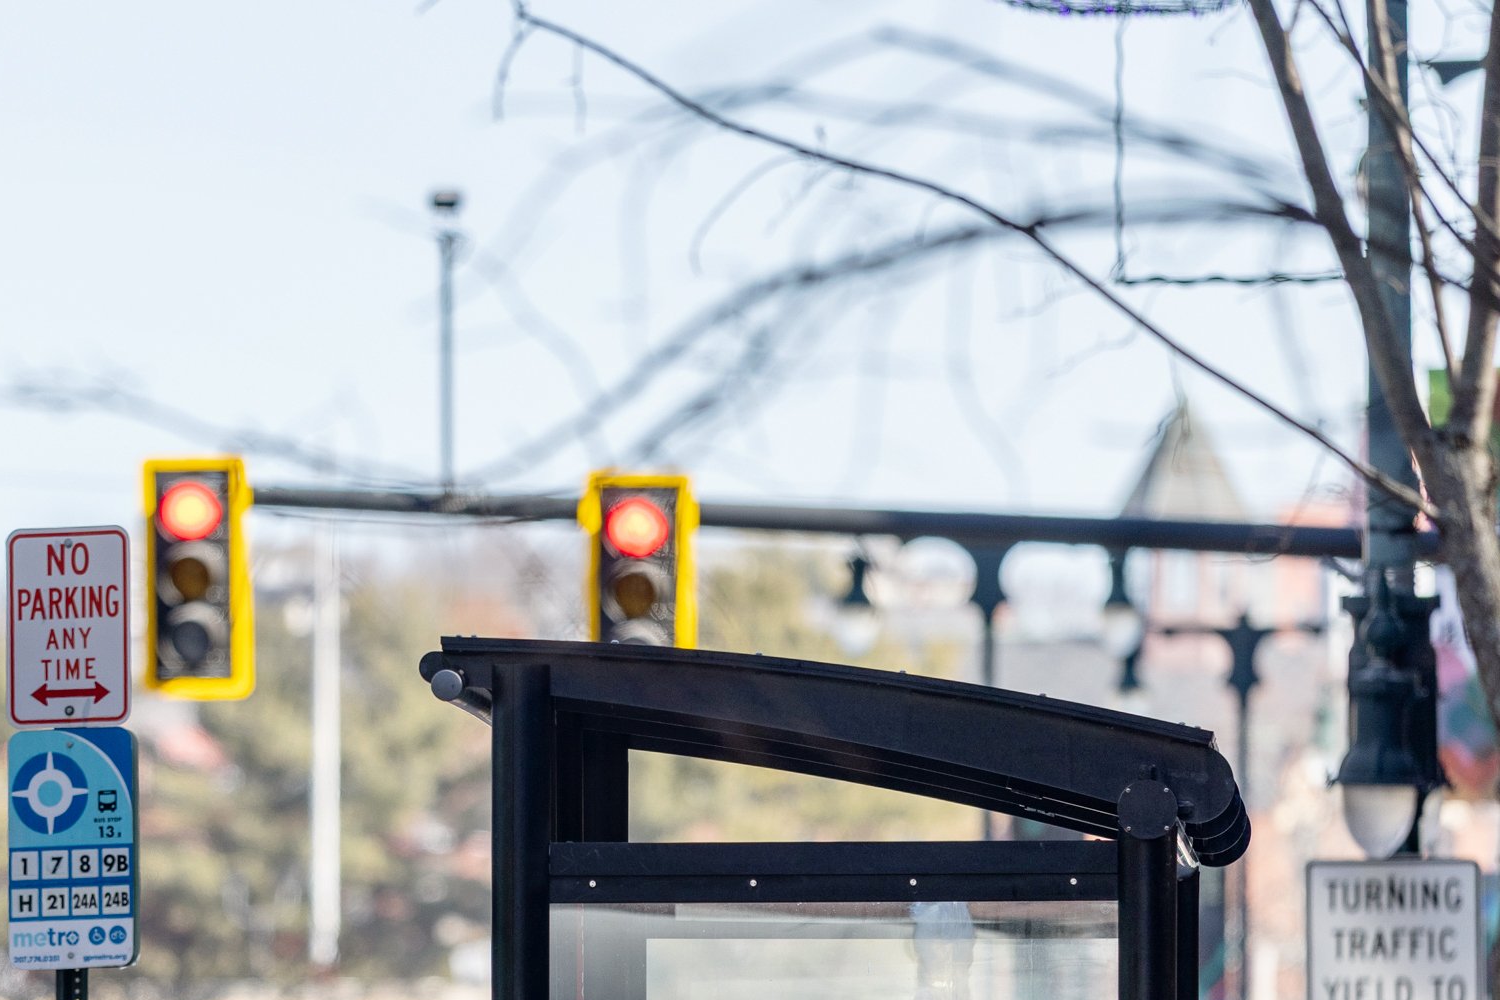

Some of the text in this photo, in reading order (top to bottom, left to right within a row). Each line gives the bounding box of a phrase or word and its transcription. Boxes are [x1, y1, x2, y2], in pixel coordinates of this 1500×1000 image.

[47, 543, 89, 576] NO
[17, 585, 119, 621] PARKING
[46, 627, 92, 650] ANY
[41, 657, 97, 681] TIME
[21, 854, 128, 876] 1 7 8 9B
[19, 892, 129, 912] H 21 24A 24B
[1326, 877, 1462, 913] TURNING
[13, 928, 80, 947] metro
[1333, 927, 1457, 962] TRAFFIC
